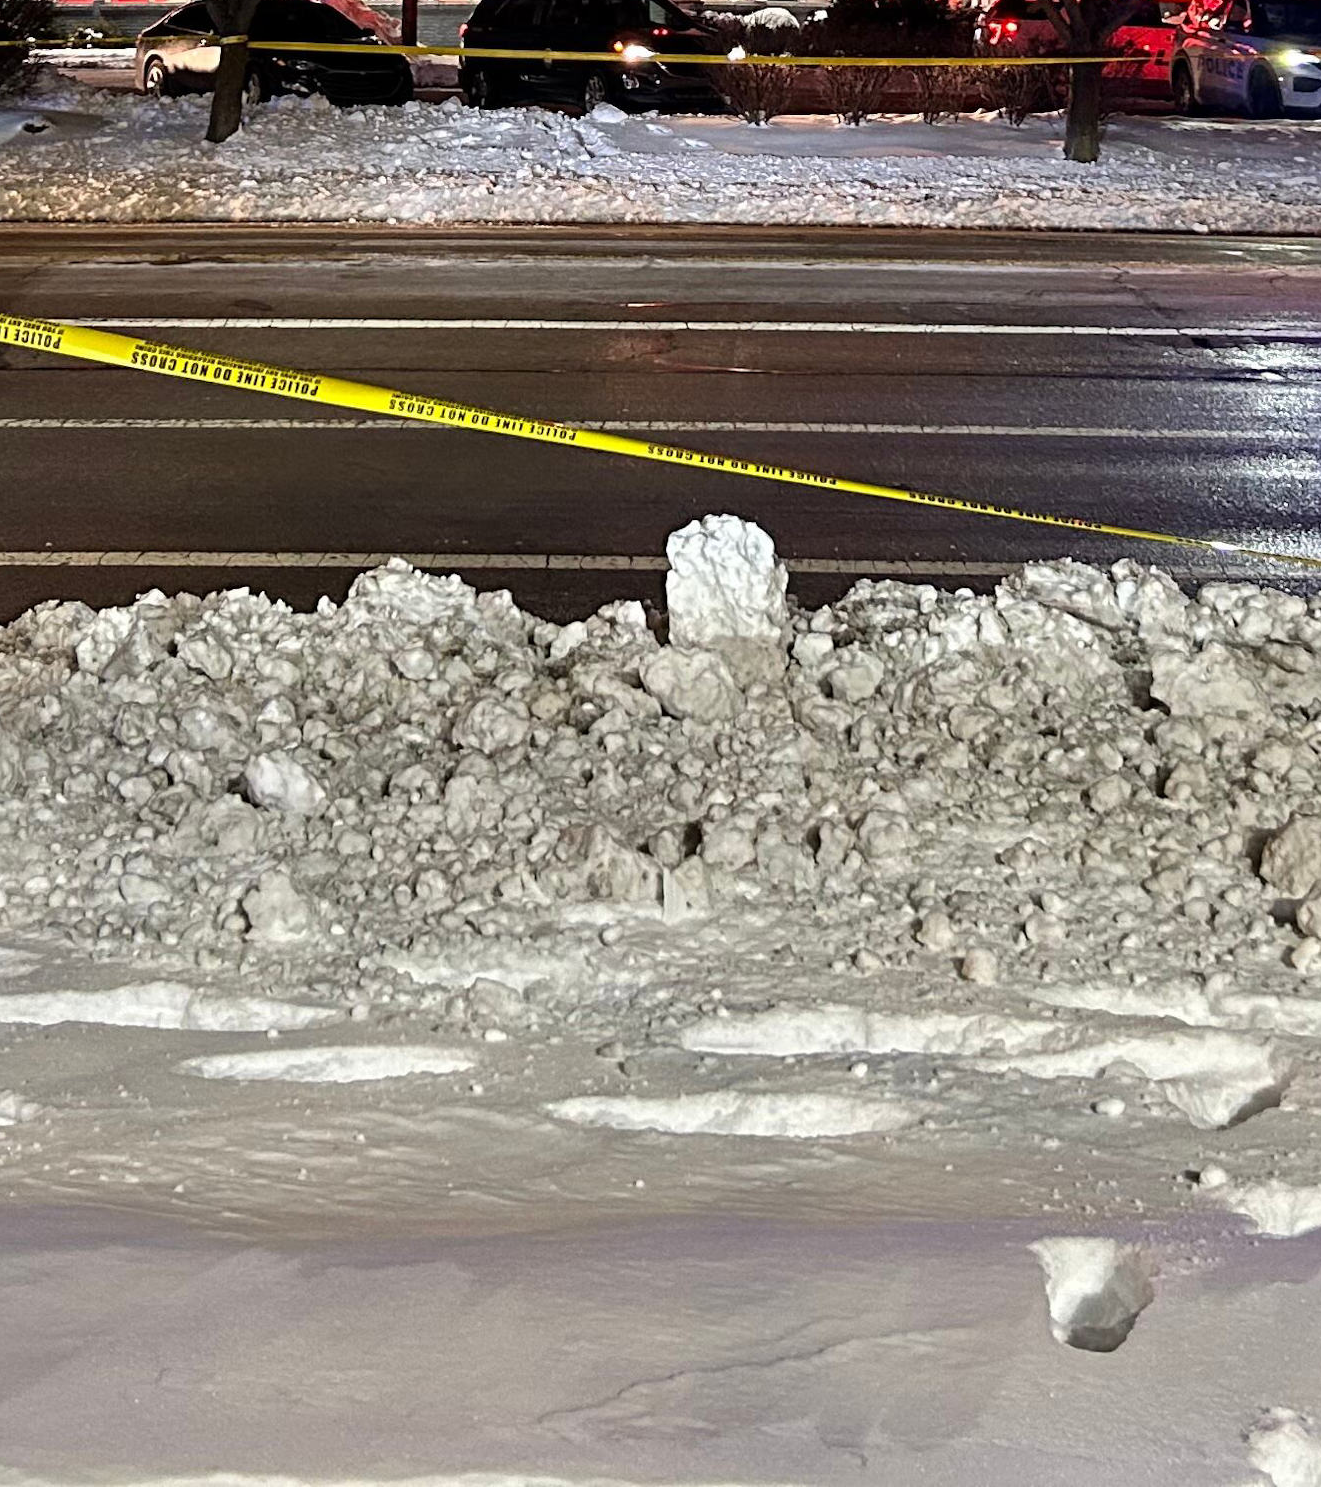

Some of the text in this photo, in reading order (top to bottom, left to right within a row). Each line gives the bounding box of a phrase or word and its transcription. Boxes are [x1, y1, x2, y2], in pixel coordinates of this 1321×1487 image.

[13, 329, 62, 350] POLICE
[131, 351, 177, 371] CROSS
[181, 361, 209, 376] NOT
[213, 367, 232, 381] DO
[237, 371, 266, 387] LINE
[270, 377, 319, 396] POLICE
[389, 399, 435, 416] CROSS
[440, 408, 466, 422] NOT
[472, 414, 489, 426] DO
[495, 419, 524, 432] LINE
[530, 424, 577, 441] POLICE
